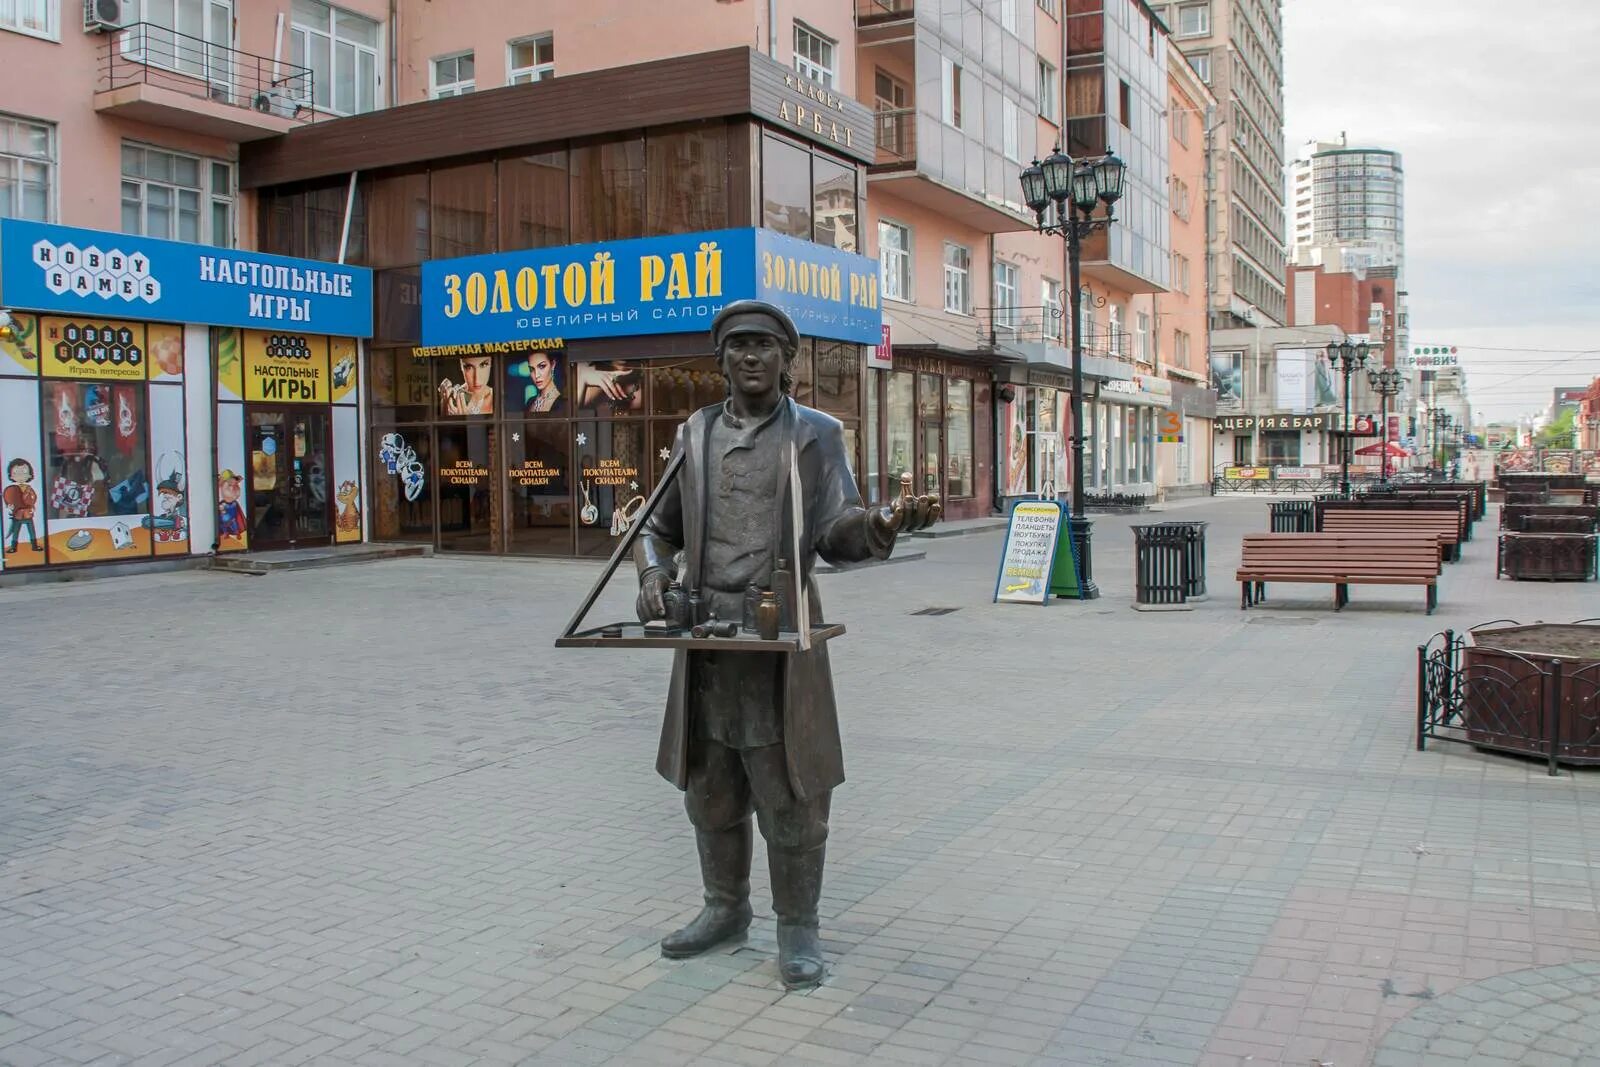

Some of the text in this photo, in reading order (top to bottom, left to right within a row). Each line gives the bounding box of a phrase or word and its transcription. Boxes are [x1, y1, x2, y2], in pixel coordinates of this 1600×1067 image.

[796, 77, 833, 108] КАФЕ
[779, 99, 854, 147] АРБАТ
[40, 247, 144, 273] HOBBY
[200, 256, 353, 297] НАСТОЛЬНЫЕ
[443, 242, 723, 318] ЗОЛОТОЙ РАЙ
[763, 251, 878, 310] ЗОЛОТОЙ РАЙ
[53, 273, 154, 296] GAMES
[249, 293, 311, 322] ИГРЫ
[516, 304, 723, 329] ЮВЕЛИРНЫЙ САЛОН
[49, 327, 129, 343] HOBBY
[59, 346, 138, 360] GAMES
[412, 337, 564, 358] ЮВЕЛИРНАЯ МАСТЕРСКАЯ
[254, 365, 319, 379] НАСТОЛЬНЫЕ
[262, 378, 317, 400] ИГРЫ
[1293, 417, 1322, 428] БАР
[455, 460, 473, 469] ВСЕМ
[524, 461, 543, 469] ВСЕМ
[600, 460, 620, 468] ВСЕМ
[441, 468, 488, 477] ПОКУПАТЕЛЯМ
[509, 468, 560, 477] ПОКУПАТЕЛЯМ
[583, 468, 637, 477] ПОКУПАТЕЛЯМ
[451, 476, 478, 485] СКИДКИ
[520, 477, 549, 485] СКИДКИ
[595, 476, 626, 485] СКИДКИ
[1017, 515, 1056, 523] ТЕЛЕФОНЫ
[1015, 523, 1056, 531] ПЛАНШЕТЫ
[1014, 531, 1051, 539] НОУТБУКИ
[1015, 540, 1047, 548] ПОКУПКА
[1012, 548, 1047, 556] ПРОДАЖА
